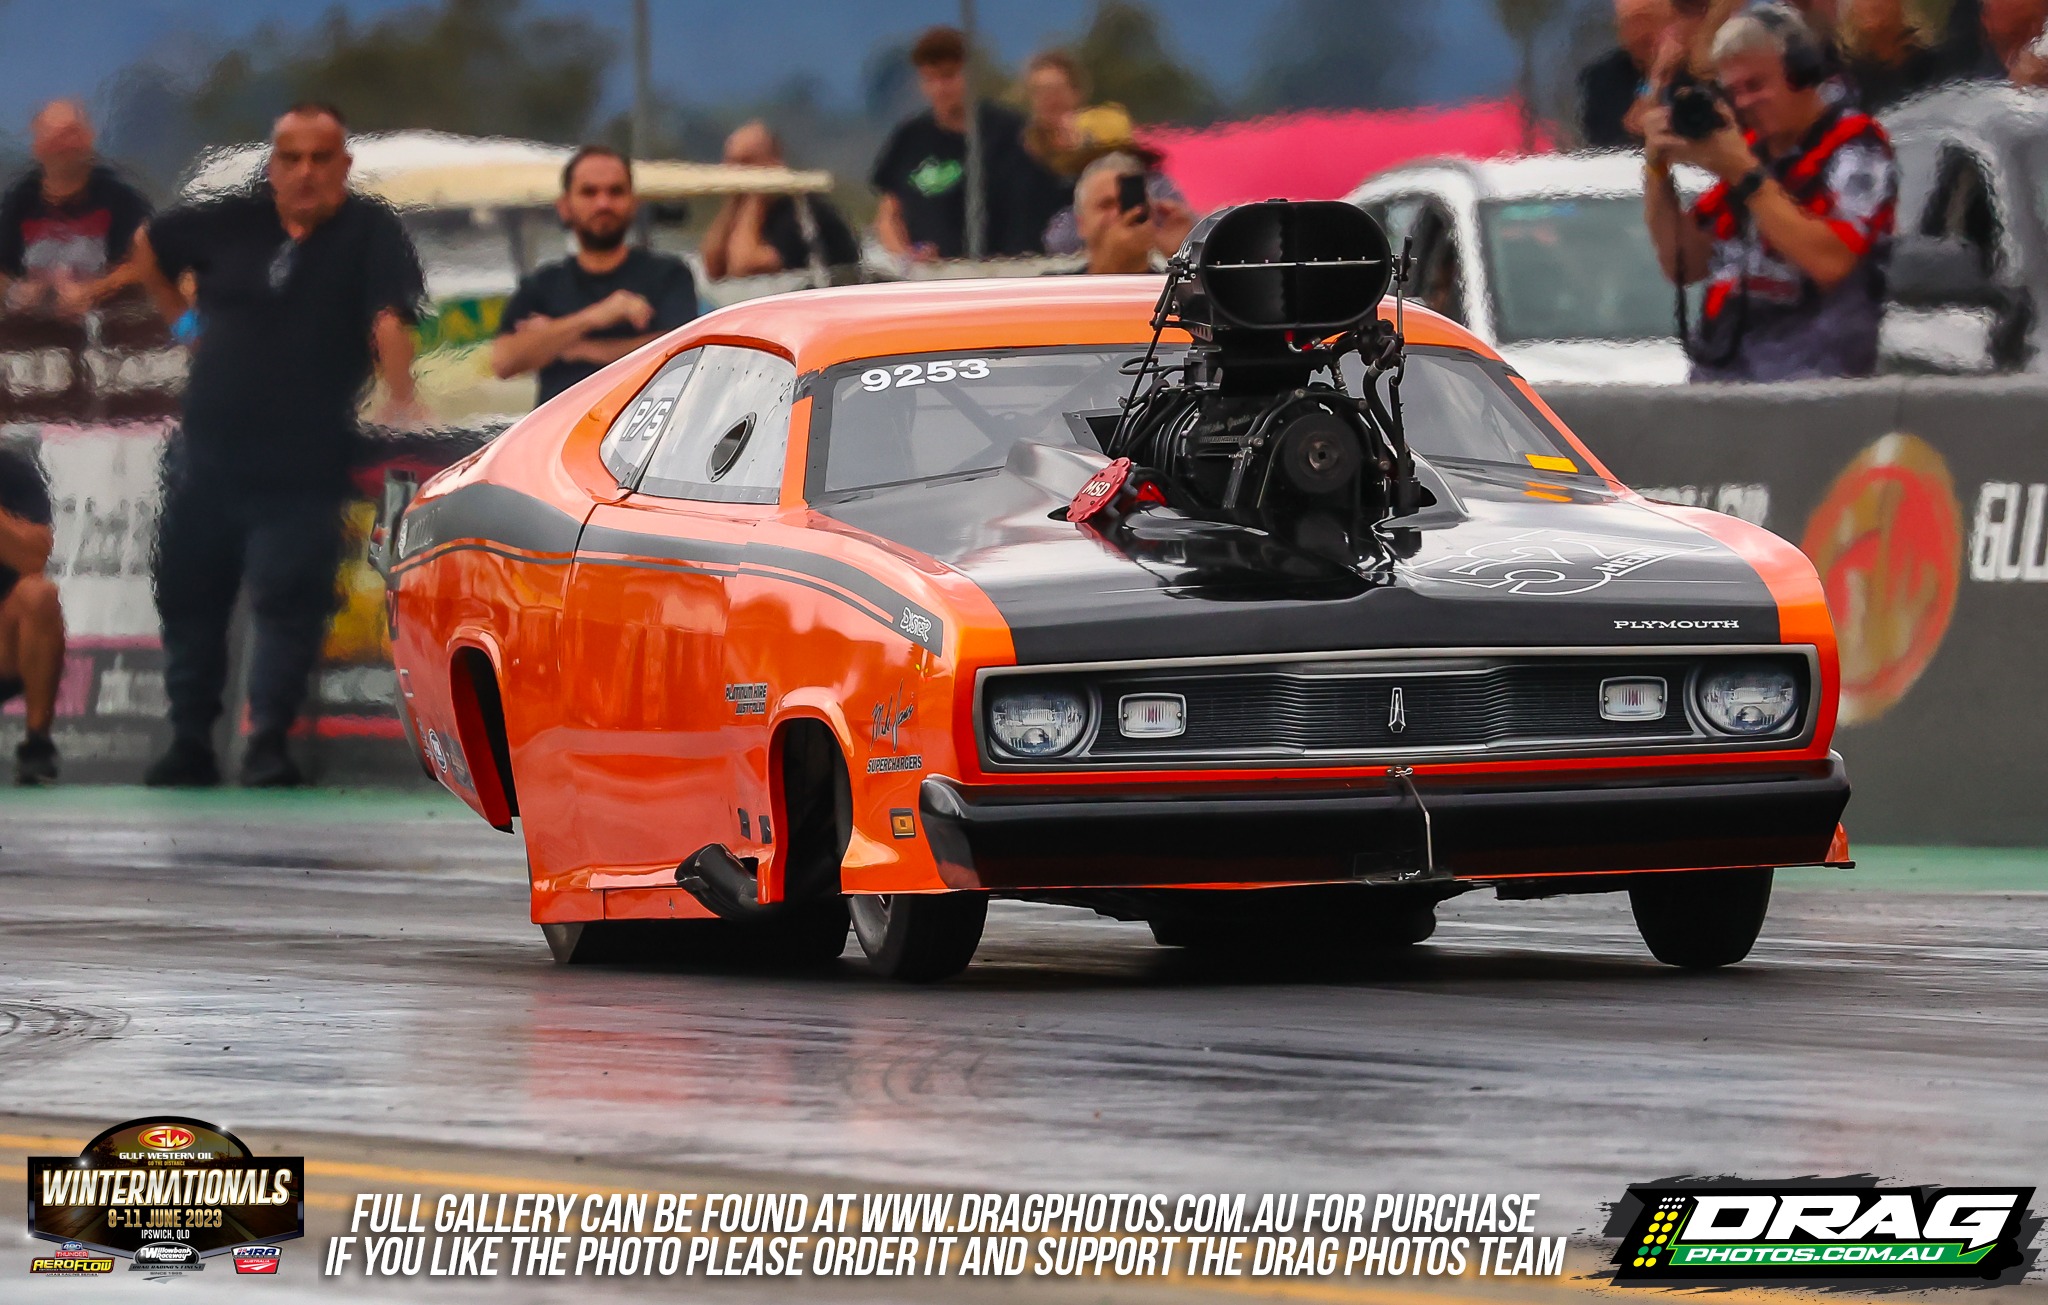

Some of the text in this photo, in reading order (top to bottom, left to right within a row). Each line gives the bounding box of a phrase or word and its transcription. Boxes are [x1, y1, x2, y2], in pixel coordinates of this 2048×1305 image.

[860, 359, 990, 392] 9253
[620, 397, 674, 441] P/S
[1081, 480, 1111, 497] MSD
[1613, 619, 1740, 629] PLYMOUTH
[867, 755, 922, 774] SUPERCHARGERS
